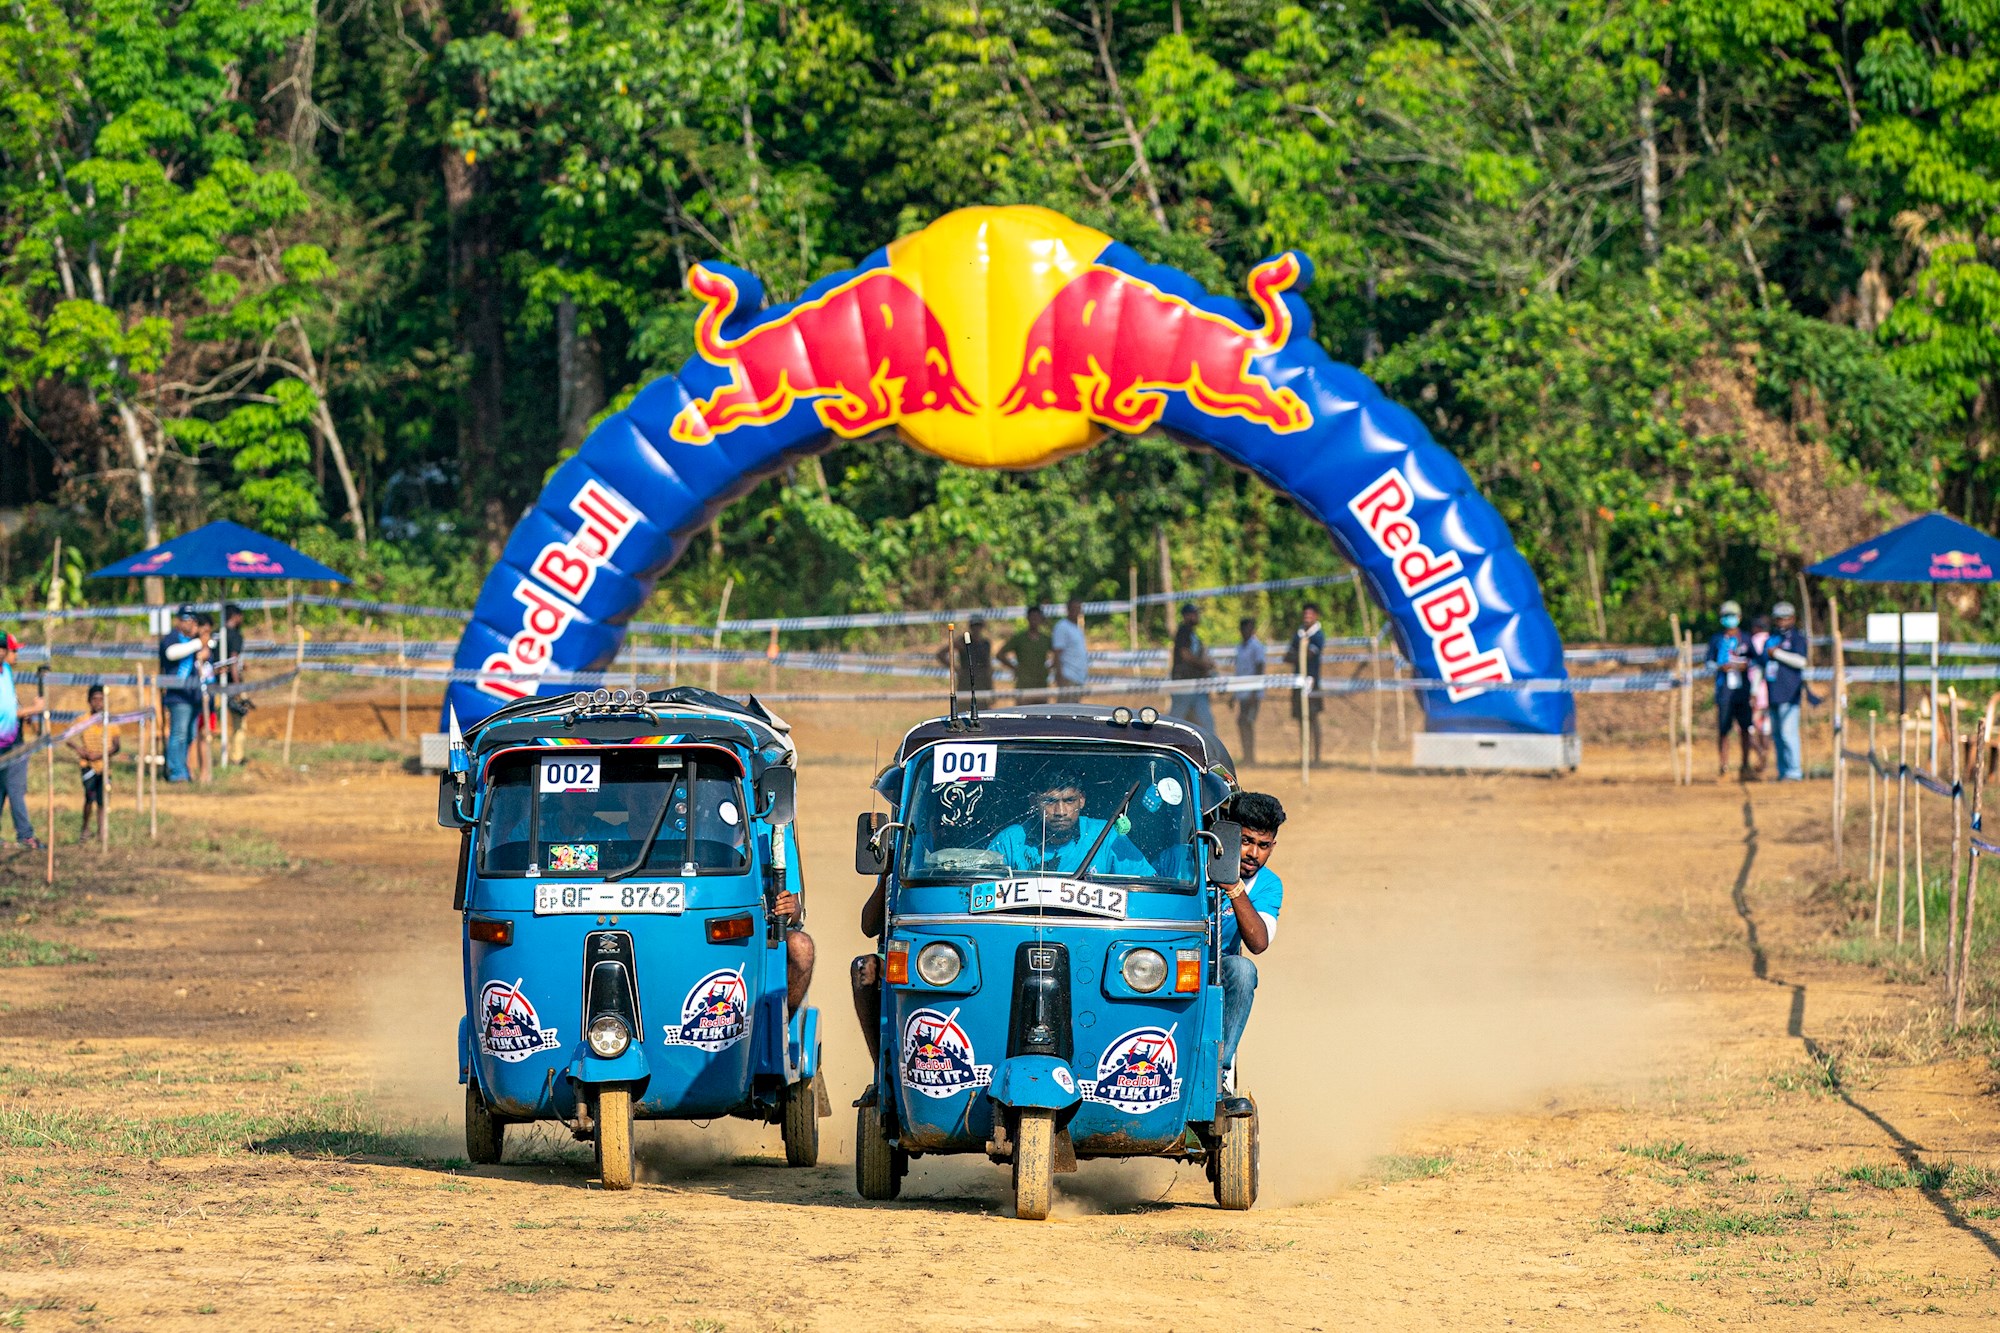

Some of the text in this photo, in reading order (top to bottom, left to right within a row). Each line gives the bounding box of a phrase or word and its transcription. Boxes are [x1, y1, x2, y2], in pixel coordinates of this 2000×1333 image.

[482, 486, 631, 699] Red Bull
[1356, 477, 1505, 695] Red Bull
[942, 752, 987, 773] 001
[547, 763, 594, 784] 002
[562, 887, 593, 908] QF
[621, 887, 681, 908] 8762
[998, 881, 1029, 904] YE
[1060, 881, 1123, 913] 5612
[490, 1024, 522, 1037] Red Bull
[699, 1013, 736, 1028] Red Bull
[915, 1058, 953, 1070] Red Bull
[1117, 1074, 1161, 1087] Red Bull
[1107, 1085, 1148, 1100] TUK
